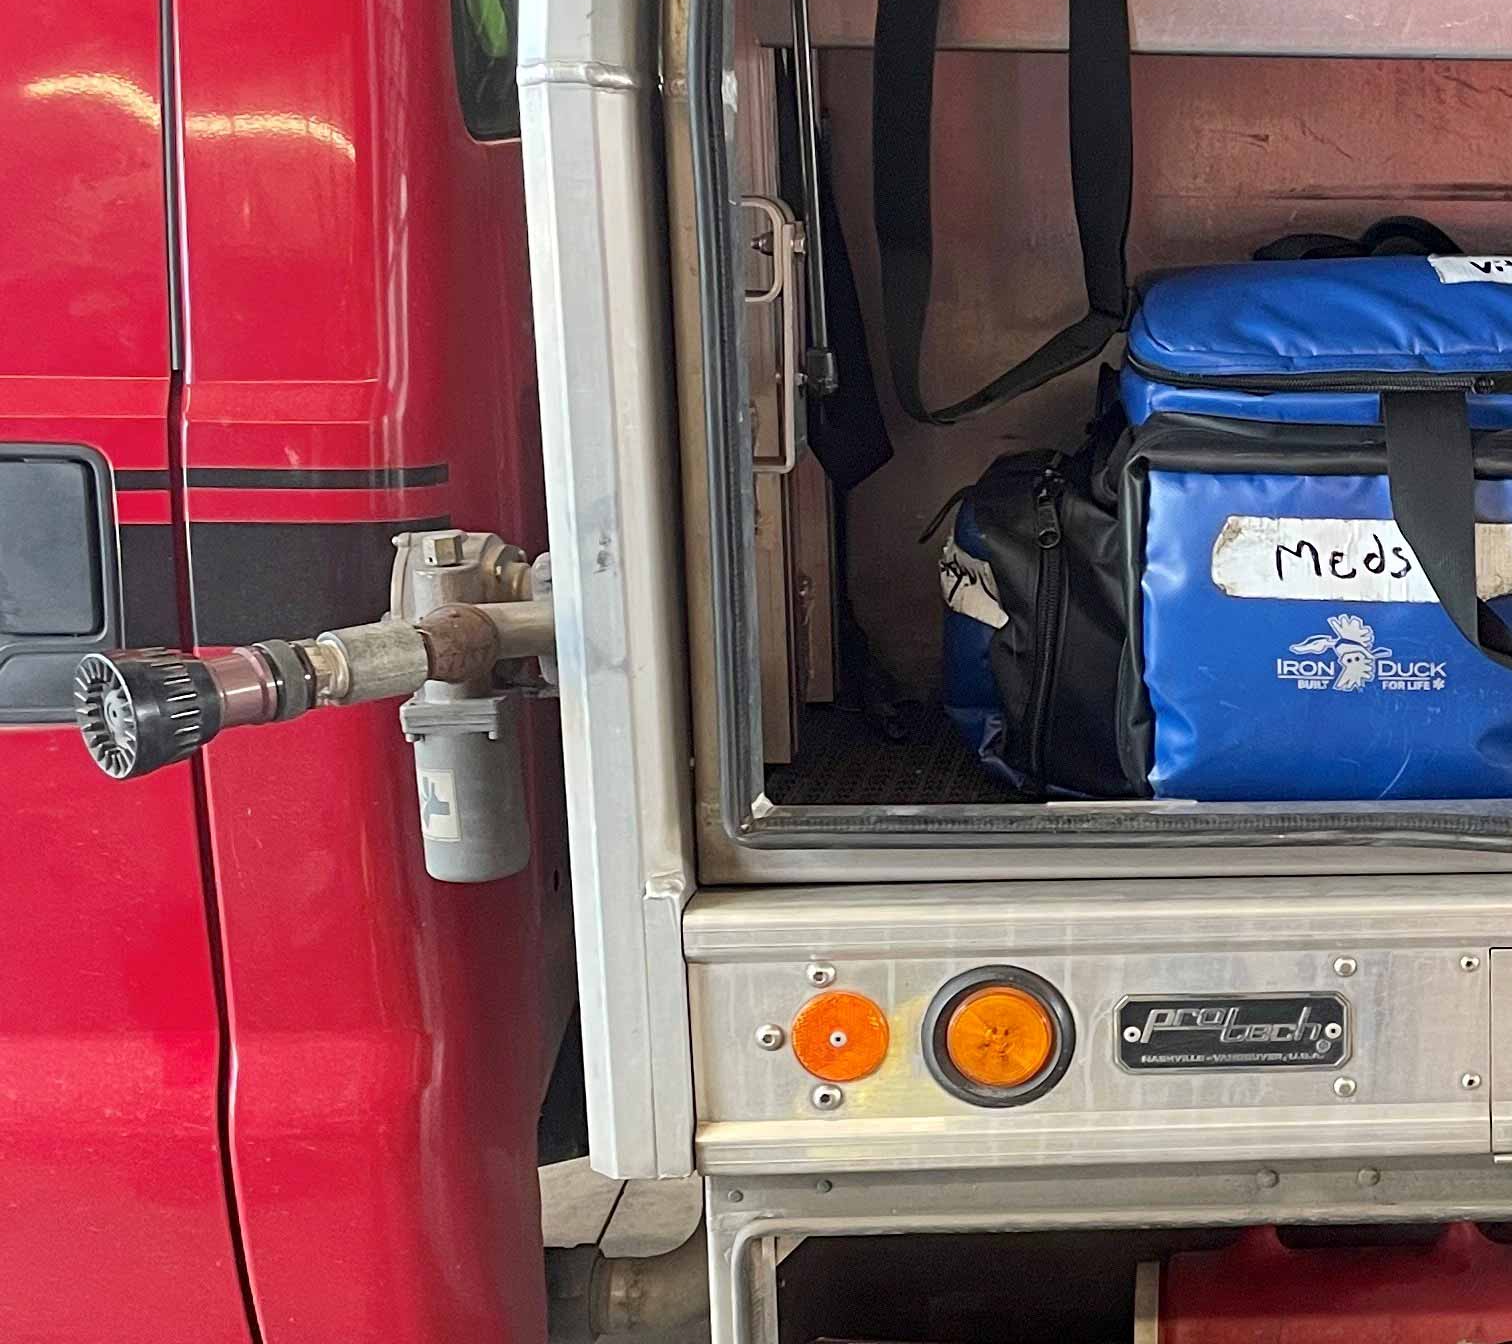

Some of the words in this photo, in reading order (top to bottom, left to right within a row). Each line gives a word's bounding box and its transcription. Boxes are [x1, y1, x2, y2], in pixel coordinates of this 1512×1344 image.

[1275, 532, 1413, 581] Meds
[1277, 658, 1335, 677] IRON
[1378, 660, 1447, 677] DUCK
[1297, 679, 1330, 690] BUILT
[1382, 679, 1406, 691] FOR
[1407, 679, 1431, 691] LIFE
